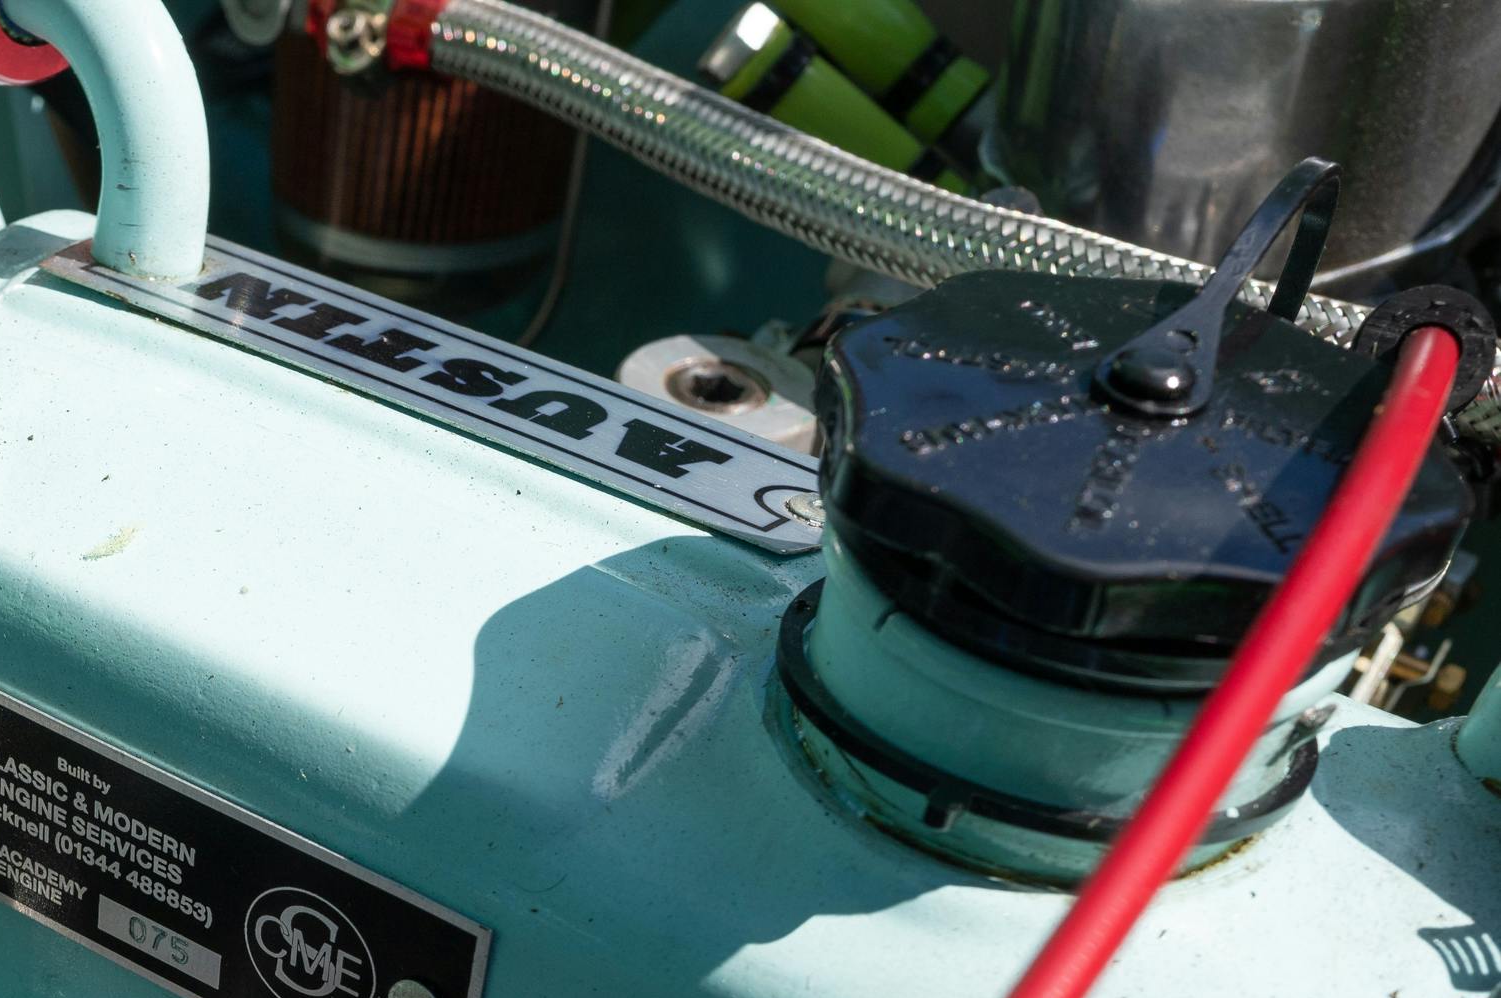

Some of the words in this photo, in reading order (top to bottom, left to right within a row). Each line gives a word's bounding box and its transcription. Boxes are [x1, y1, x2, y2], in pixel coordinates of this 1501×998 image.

[195, 271, 734, 479] AUSTIN
[57, 756, 91, 784] Built
[92, 774, 111, 795] by
[72, 816, 183, 885] SERVICES
[73, 791, 89, 815] &
[94, 800, 196, 867] MODERN
[54, 831, 122, 879] (01344
[126, 870, 213, 929] 488853)
[128, 915, 189, 966] 075
